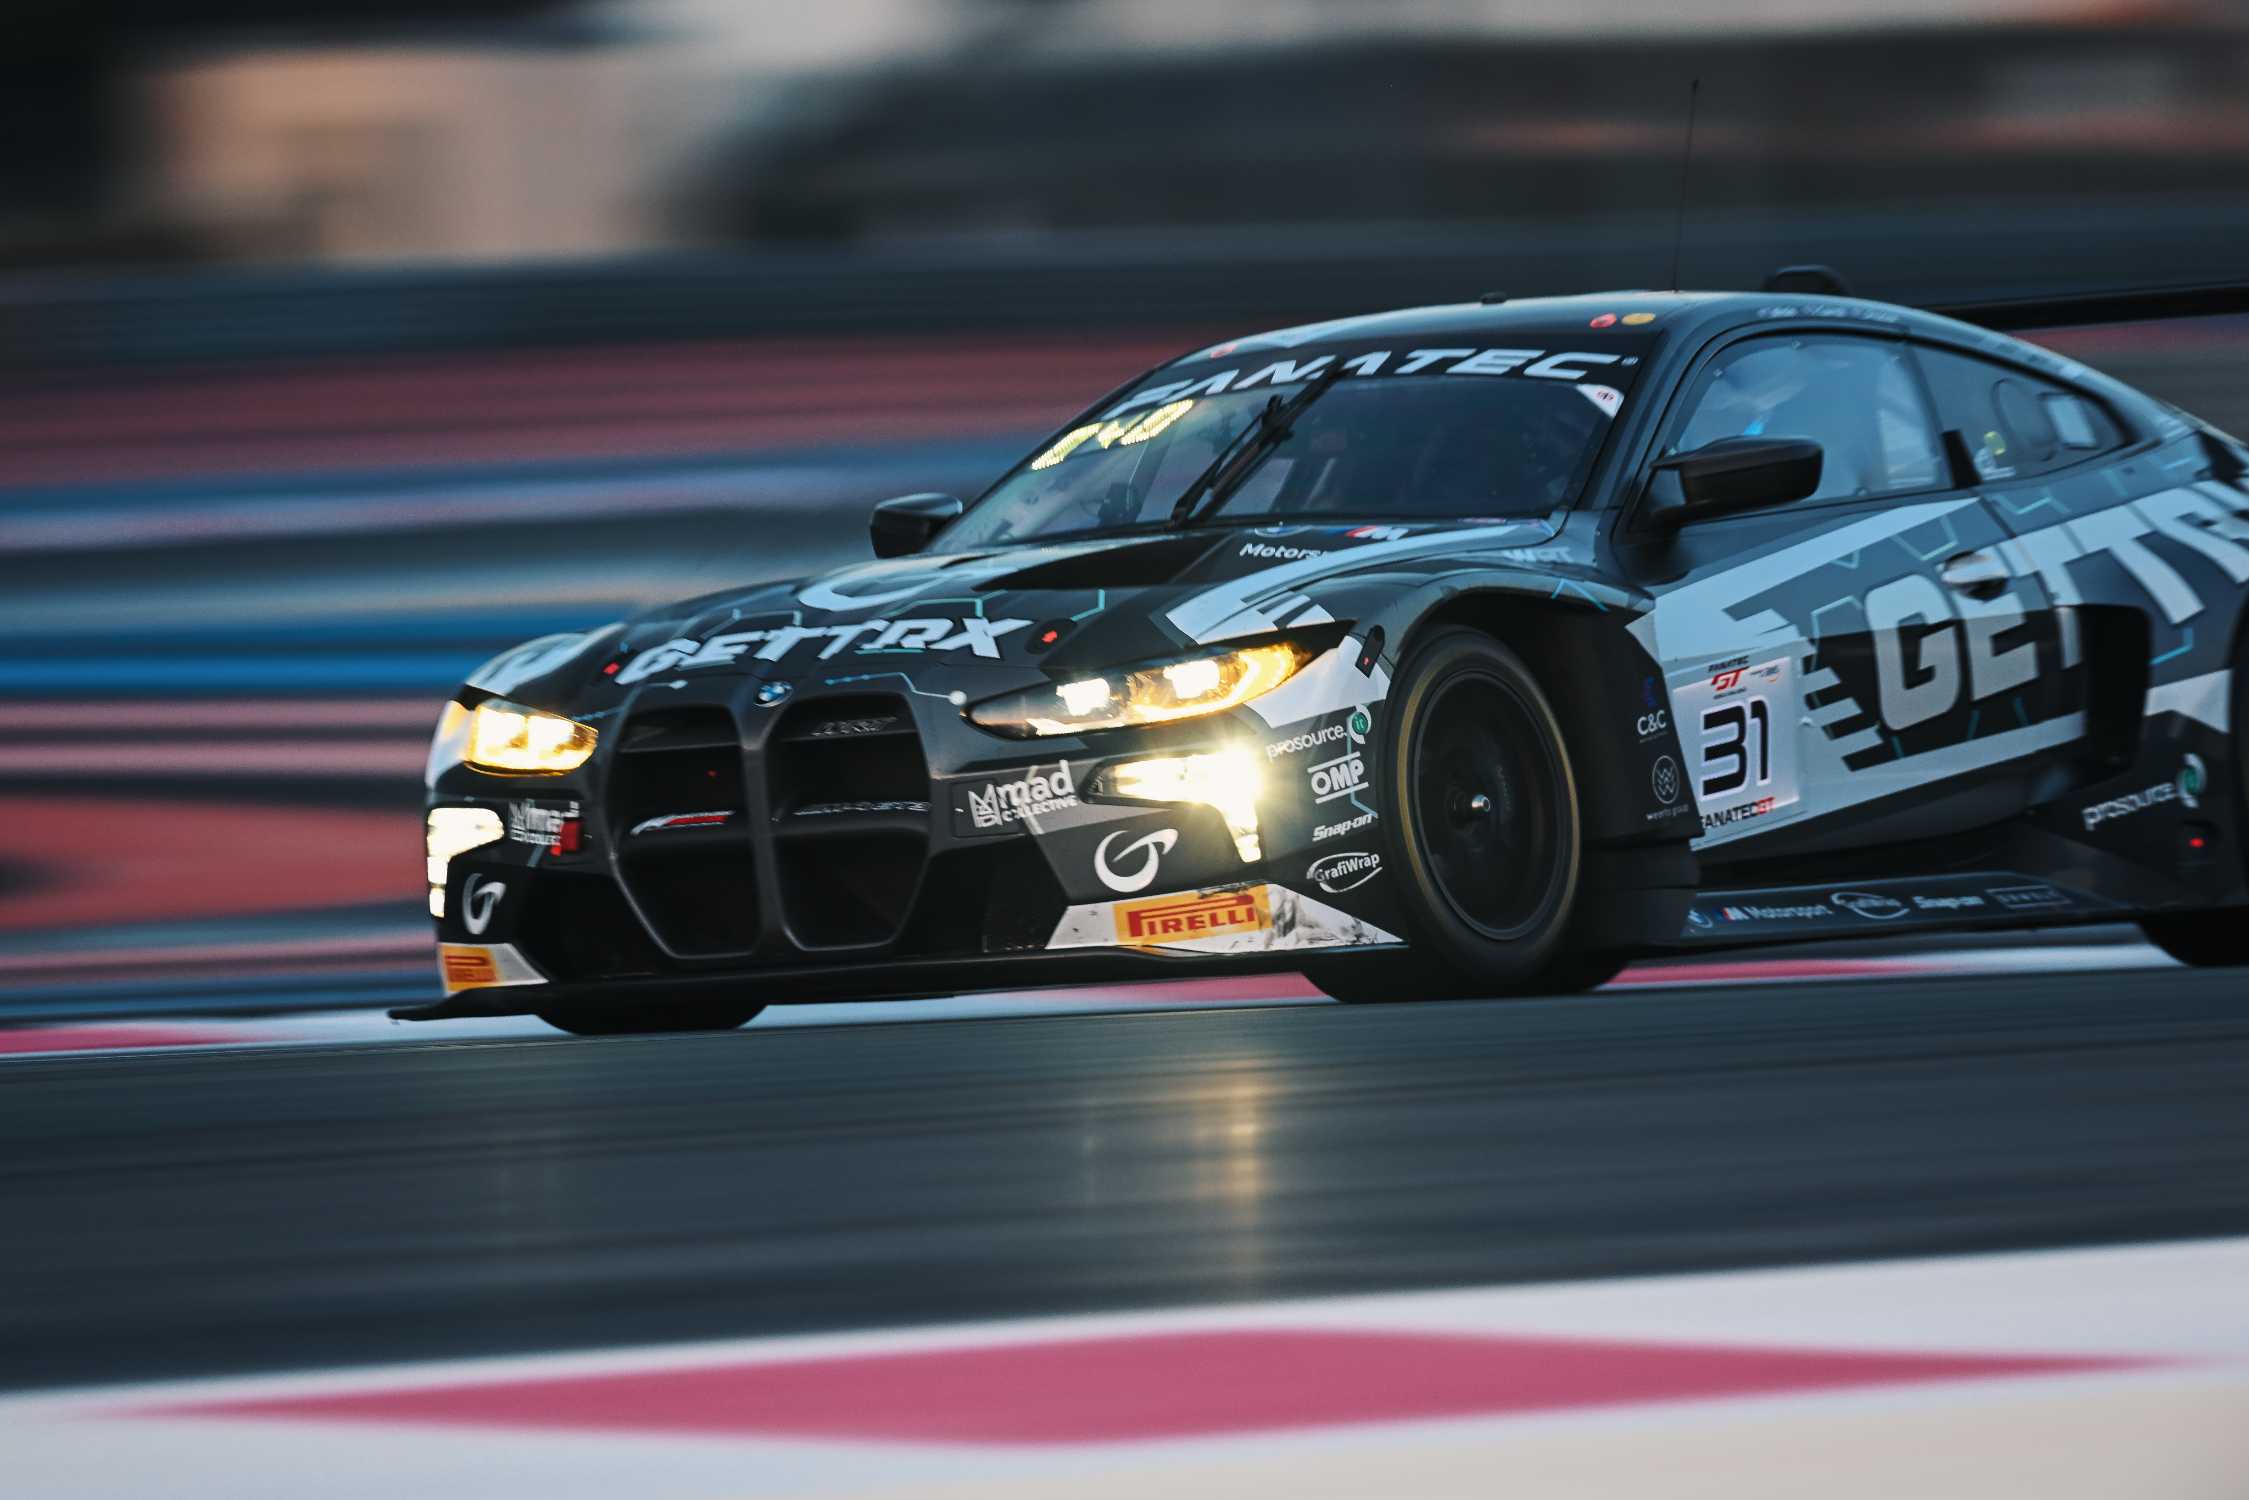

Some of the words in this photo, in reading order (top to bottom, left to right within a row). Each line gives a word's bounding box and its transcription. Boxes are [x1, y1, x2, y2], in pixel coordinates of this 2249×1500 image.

[614, 617, 1035, 685] GETTRX
[1637, 709, 1667, 736] C&C
[1703, 699, 1768, 796] 31
[1311, 759, 1364, 796] OMP
[1312, 813, 1372, 842] Snap-on
[1315, 854, 1380, 882] GrafiWrap
[1126, 894, 1256, 938] PIRELLI
